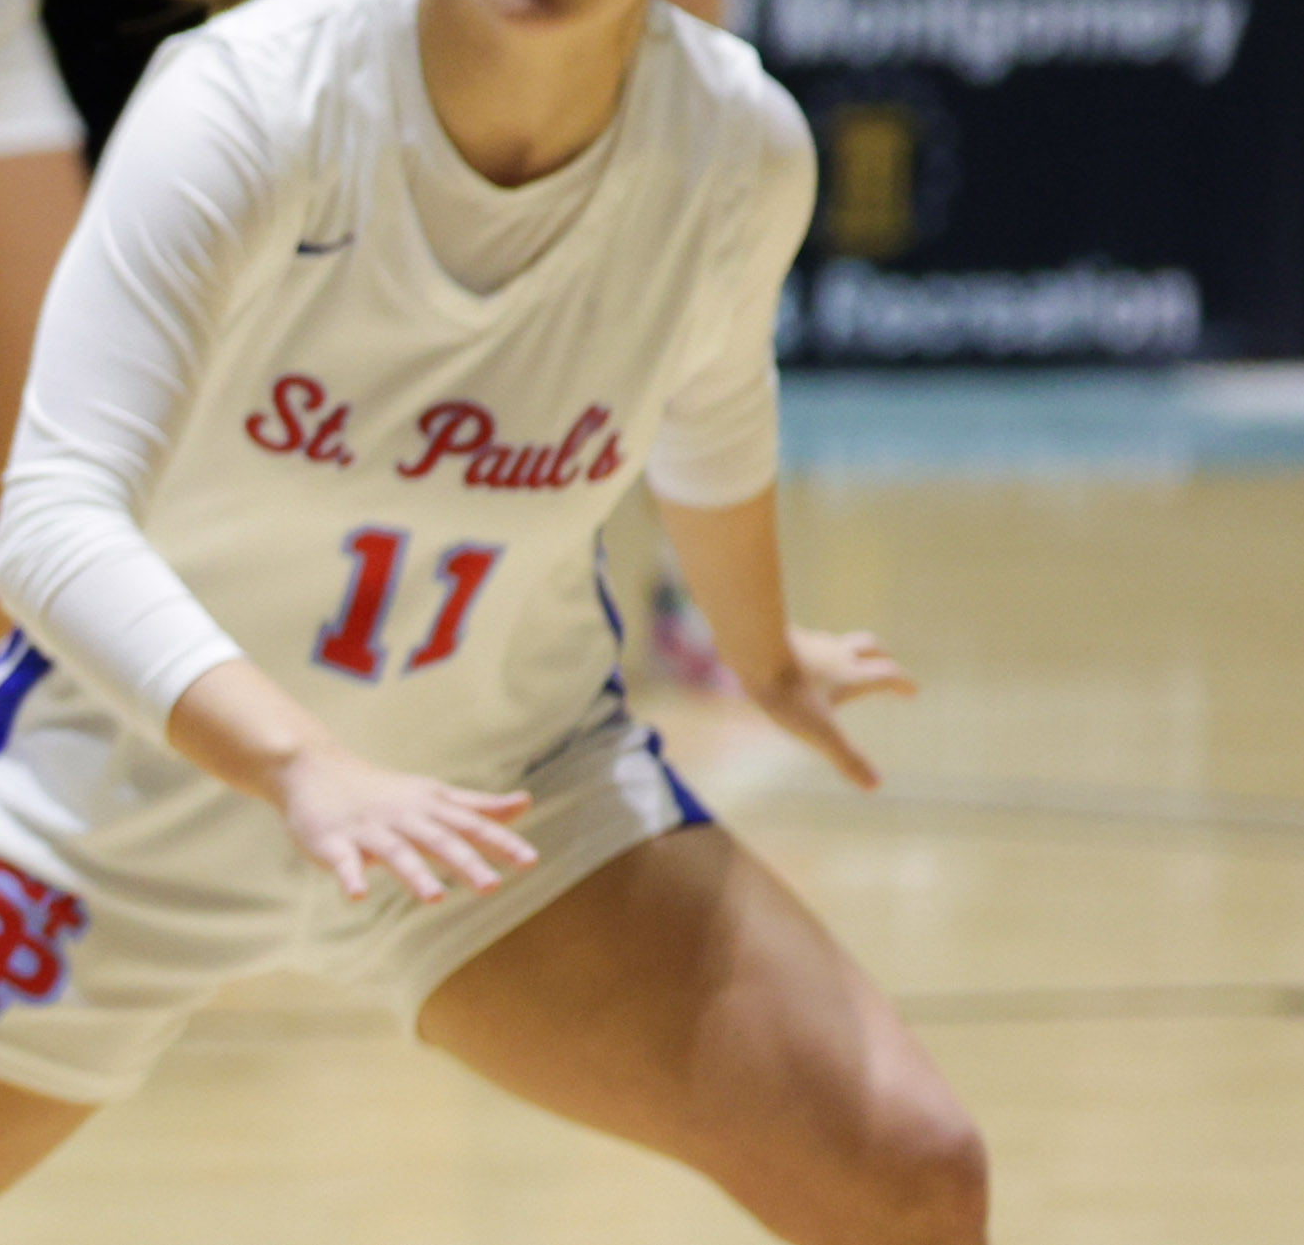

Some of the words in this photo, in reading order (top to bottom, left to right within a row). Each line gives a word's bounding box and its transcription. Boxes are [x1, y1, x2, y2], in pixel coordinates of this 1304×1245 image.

[244, 373, 358, 470] St.
[396, 399, 629, 490] Paul's
[313, 523, 504, 682] 11
